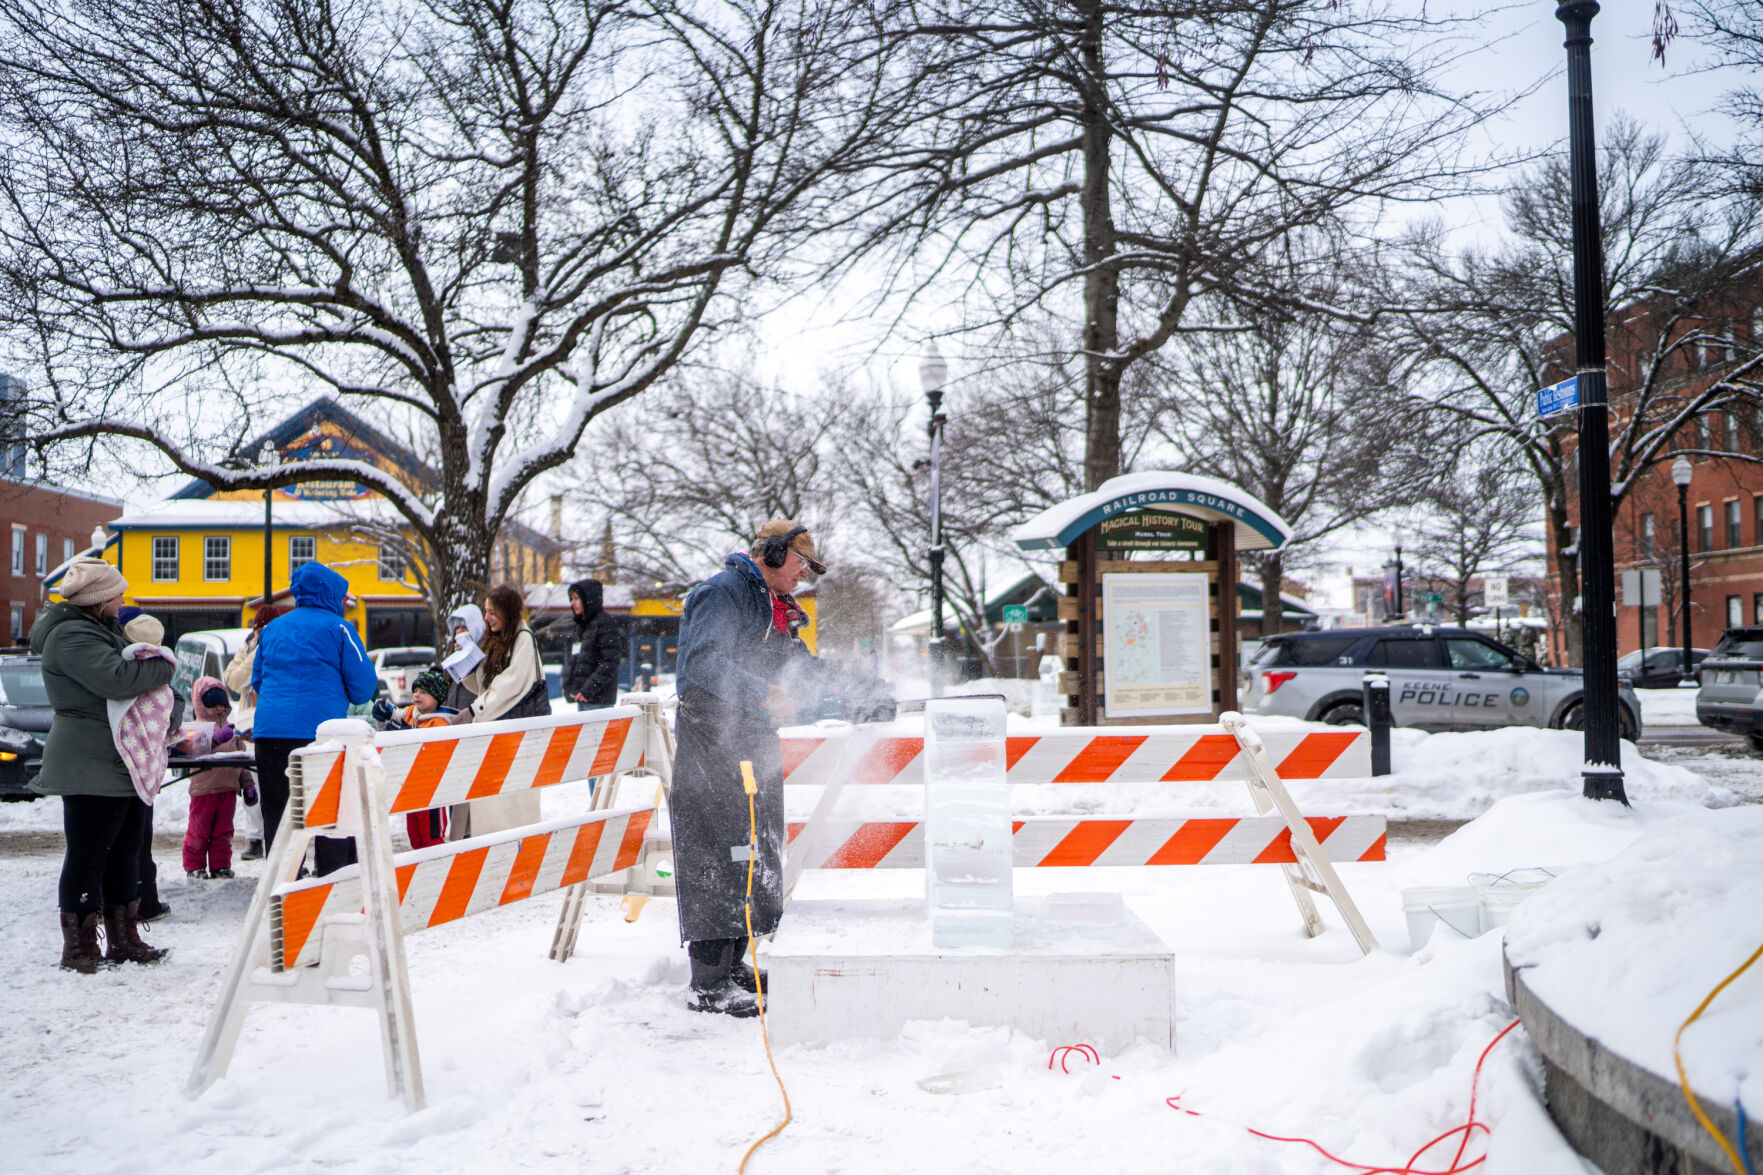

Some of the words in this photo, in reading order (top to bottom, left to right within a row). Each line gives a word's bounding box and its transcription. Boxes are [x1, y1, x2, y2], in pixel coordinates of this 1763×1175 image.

[1102, 491, 1177, 515] RAILROAD
[1187, 492, 1245, 518] SQUARE
[1101, 516, 1140, 534] MAGICAL
[1142, 513, 1179, 528] HISTORY
[1180, 517, 1204, 533] TOUR
[1490, 582, 1502, 592] NO
[1338, 656, 1353, 665] 31
[1403, 681, 1451, 691] KEENE
[1399, 690, 1499, 707] POLICE
